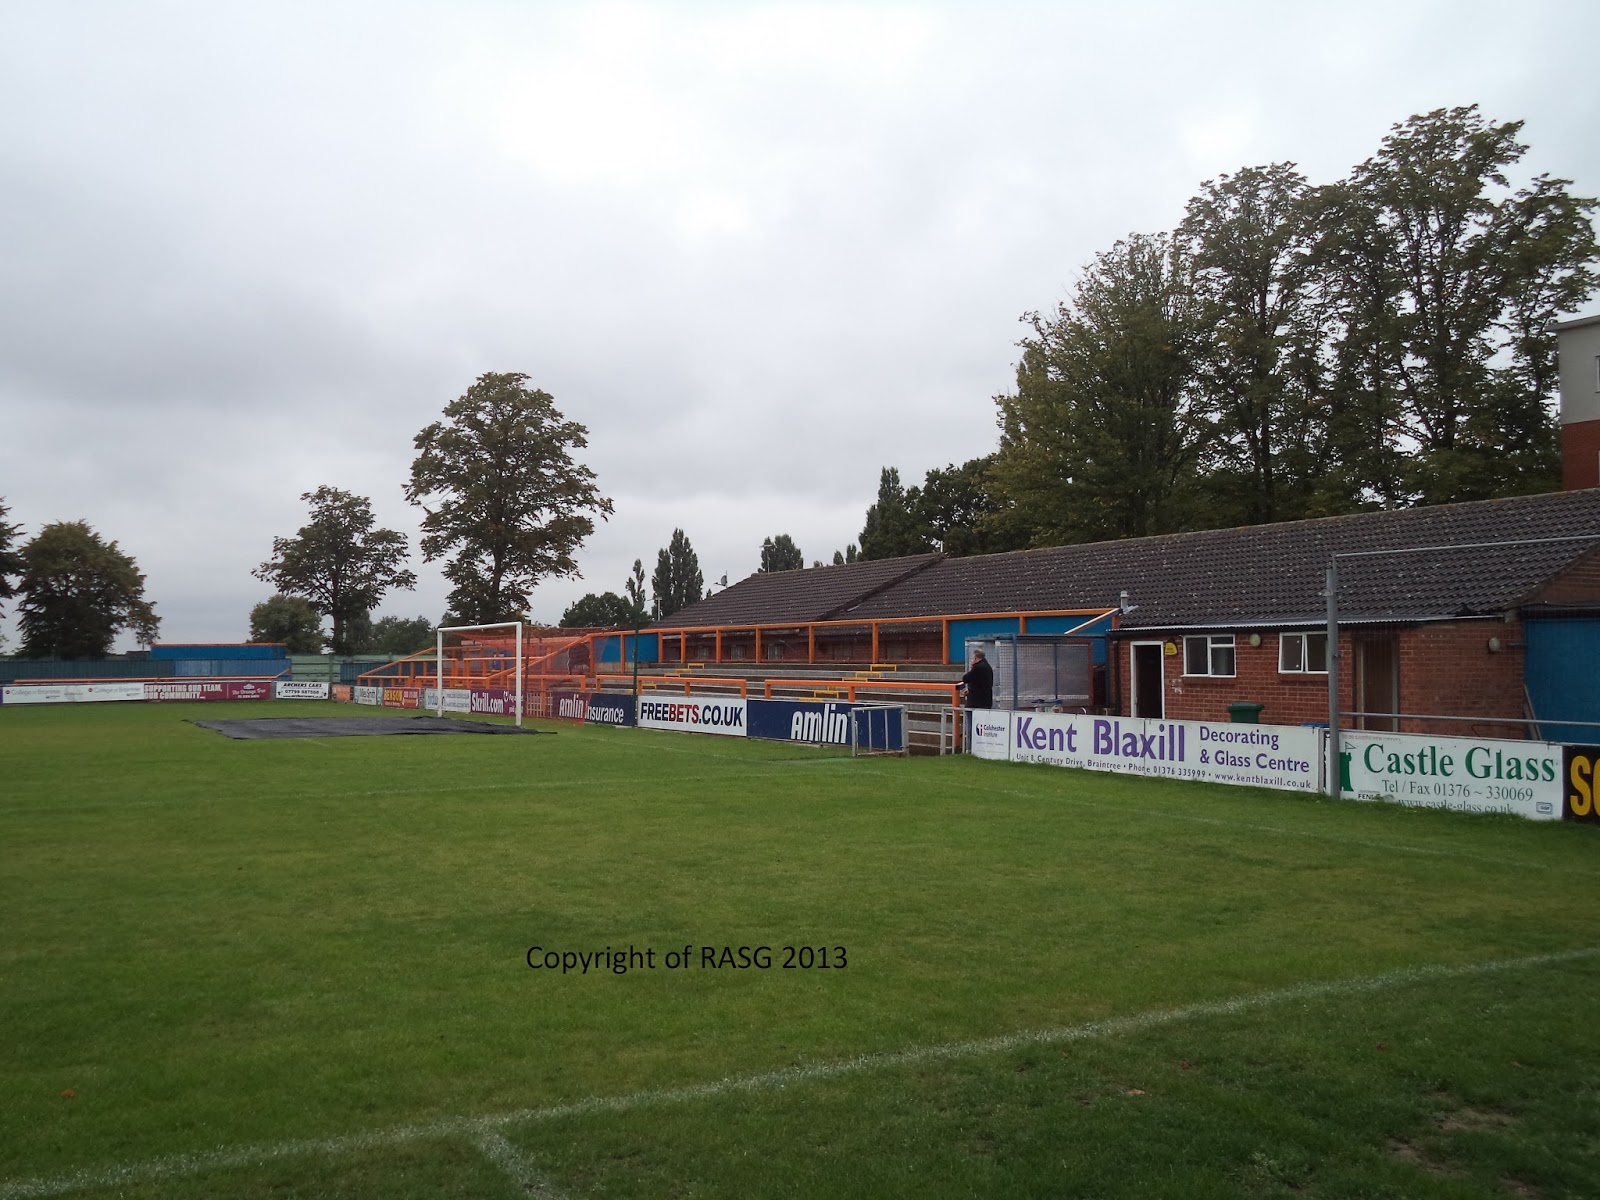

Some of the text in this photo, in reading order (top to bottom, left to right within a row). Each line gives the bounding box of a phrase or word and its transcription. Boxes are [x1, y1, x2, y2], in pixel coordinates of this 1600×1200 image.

[144, 684, 223, 693] SUPPORTING OUR TEAM,
[144, 692, 159, 700] OUR
[472, 691, 504, 714] Skrill.com
[585, 699, 624, 724] insurance
[640, 702, 744, 728] FREEBETS.CO.UK
[983, 724, 1005, 732] Colchester
[1016, 716, 1185, 763] Kent Blaxill
[1200, 726, 1279, 751] Decorating
[1016, 753, 1030, 761] Unit
[1037, 755, 1064, 766] Century
[1087, 760, 1122, 770] Braintree
[1128, 763, 1151, 773] Phone
[1153, 766, 1176, 775] 01376
[1178, 768, 1206, 778] 335999
[1214, 771, 1312, 790] www.kentblaxill.co.uk
[1200, 749, 1310, 773] & Glass Centre
[1363, 743, 1556, 782] Castle Glass
[1381, 779, 1399, 793] Tel
[1409, 781, 1430, 795] Fax
[1433, 783, 1470, 798] 01376
[1486, 785, 1534, 801] 330069
